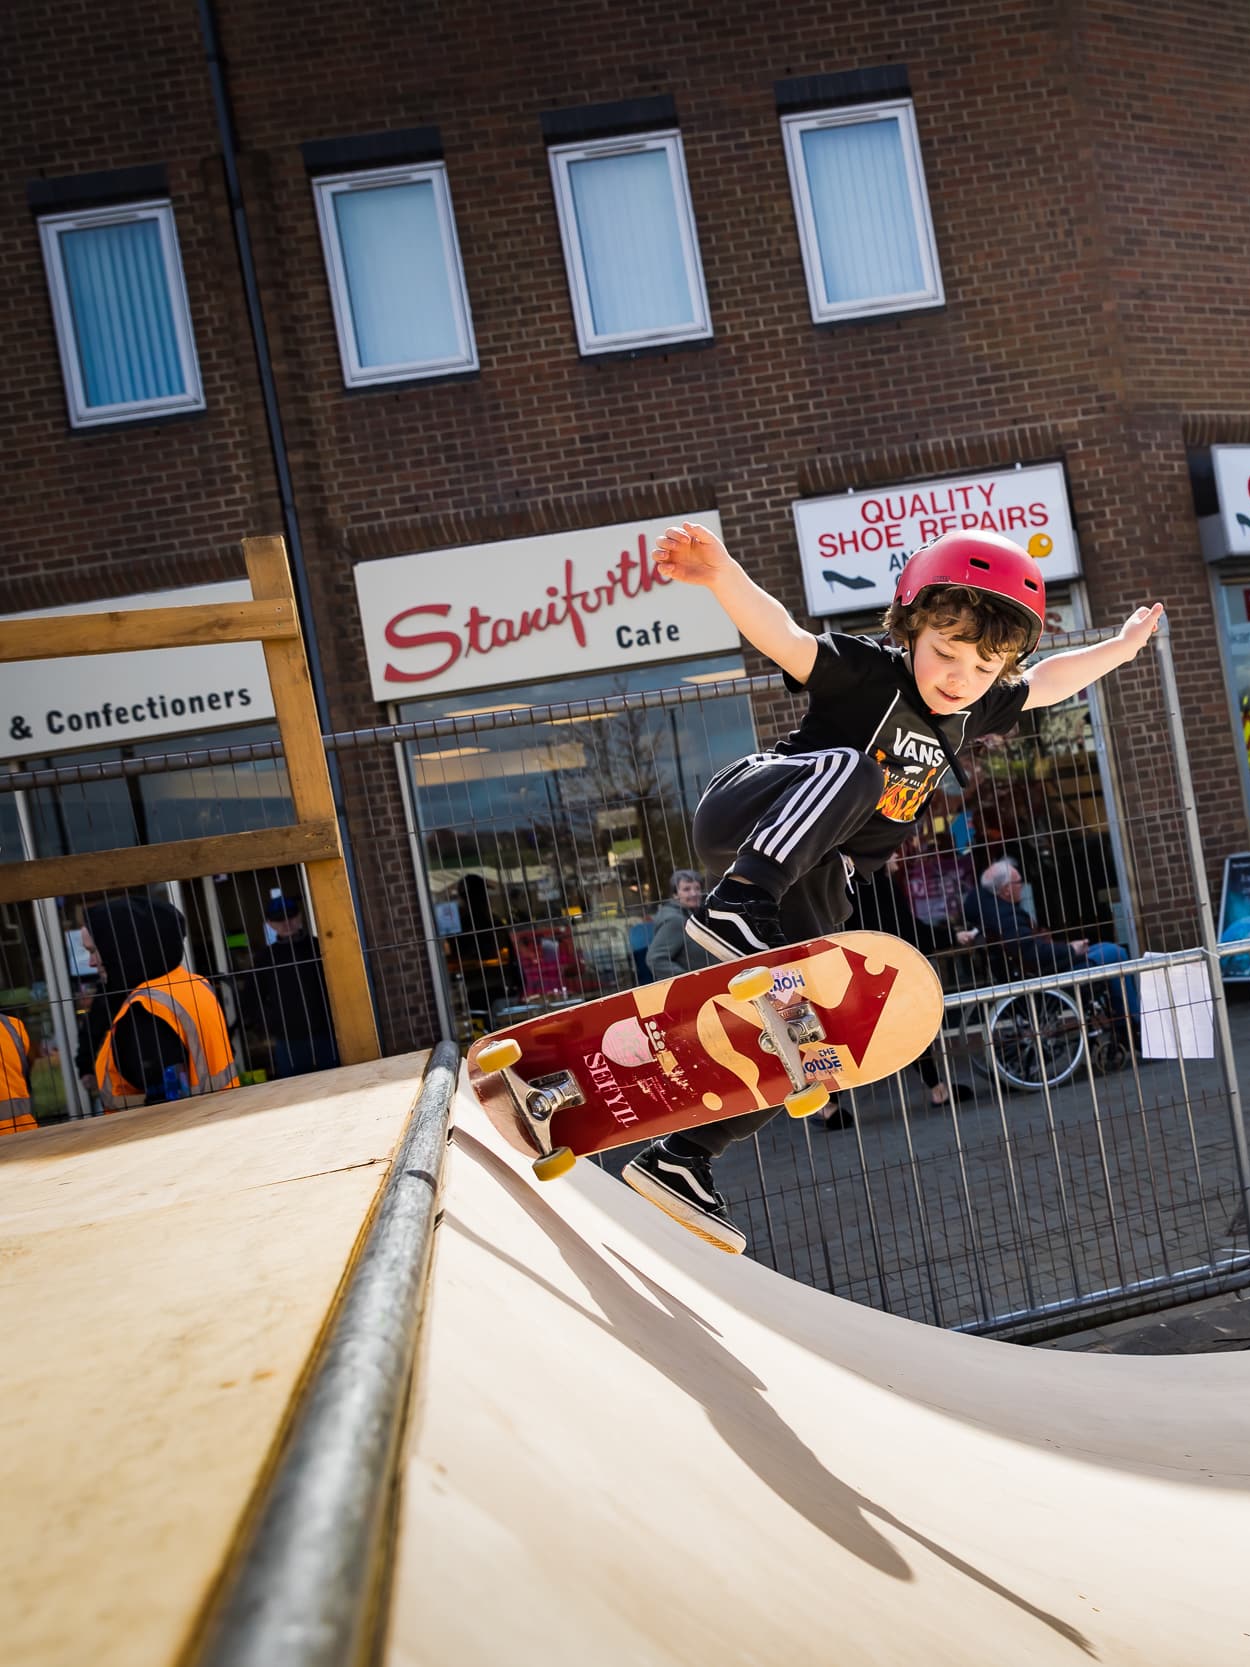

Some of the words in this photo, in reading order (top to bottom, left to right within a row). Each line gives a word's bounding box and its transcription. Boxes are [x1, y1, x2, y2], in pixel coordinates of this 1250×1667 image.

[860, 483, 996, 525] QUALITY
[817, 524, 904, 558] SHOE
[919, 502, 1049, 544] REPAIRS
[615, 620, 681, 649] Cafe
[9, 714, 33, 741] &
[46, 687, 253, 735] Confectioners
[893, 727, 946, 767] VANS
[803, 1056, 842, 1074] OUSE
